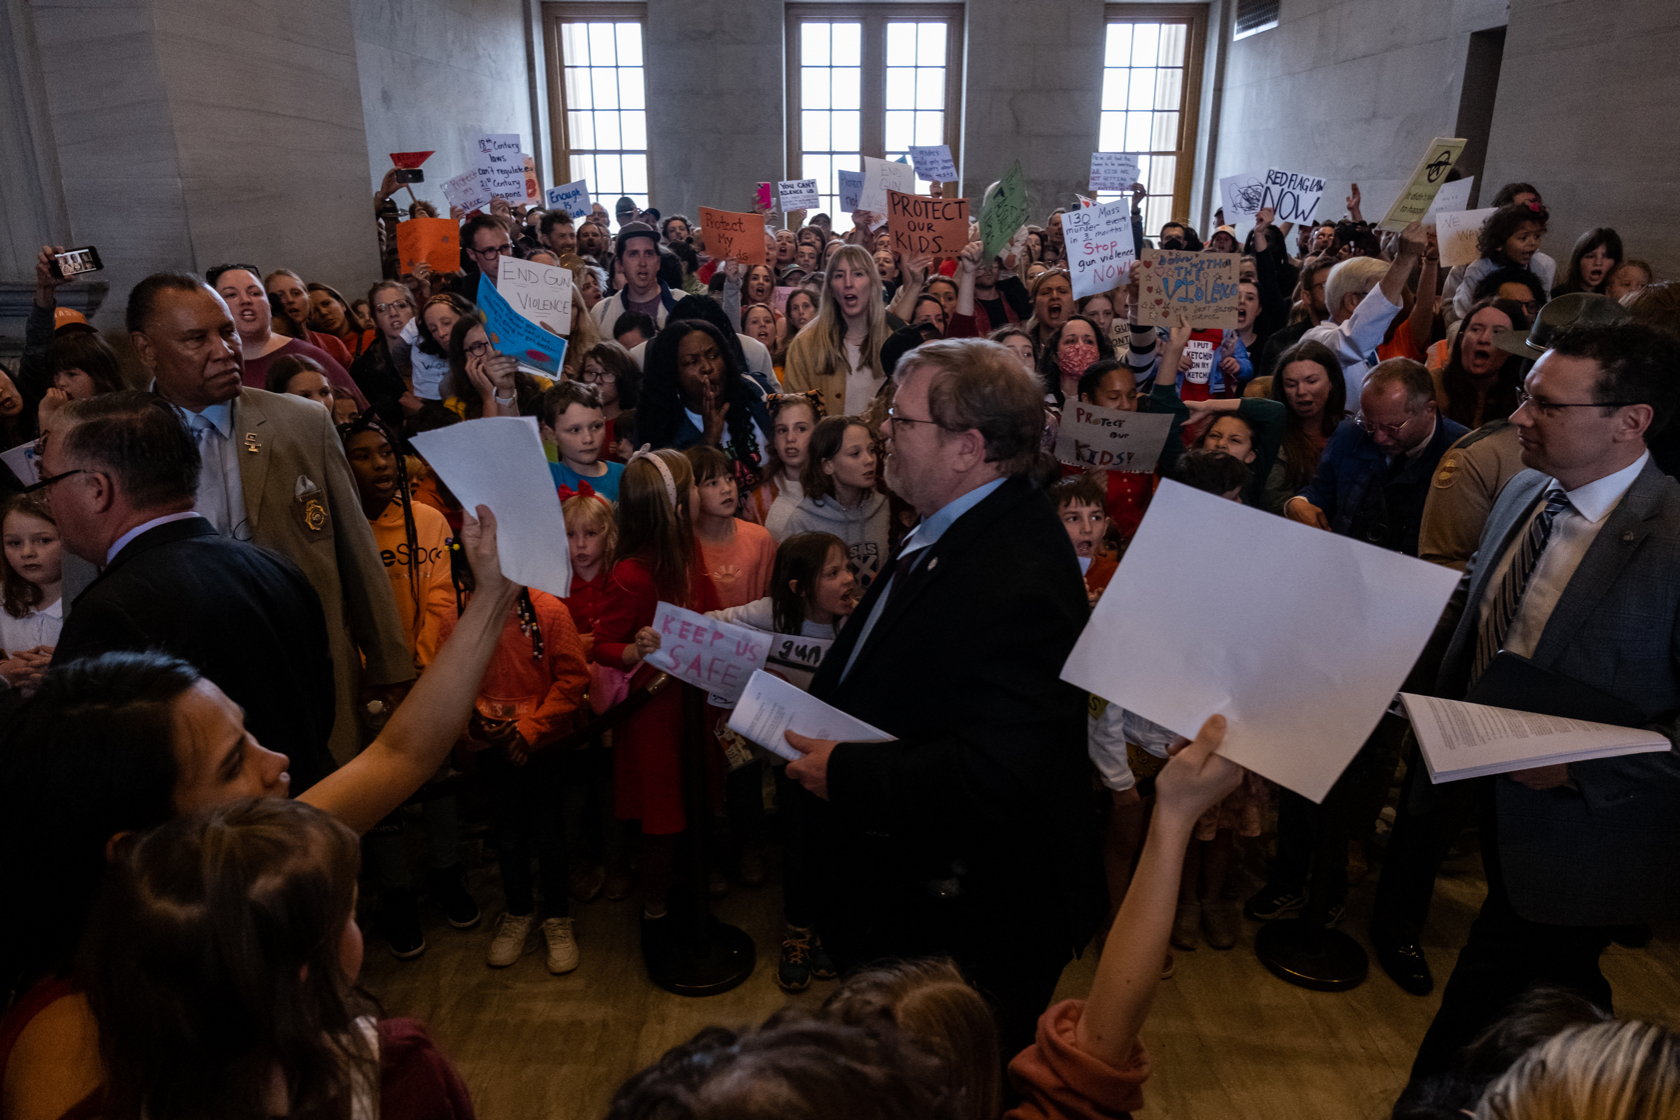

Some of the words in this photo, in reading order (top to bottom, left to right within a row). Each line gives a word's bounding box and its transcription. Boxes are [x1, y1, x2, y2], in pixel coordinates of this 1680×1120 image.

[494, 141, 520, 154] Century
[489, 154, 507, 162] laws
[478, 166, 495, 176] can't
[880, 163, 902, 178] END
[493, 179, 521, 190] Century
[1265, 169, 1288, 187] RED
[1288, 173, 1310, 194] FLAG
[549, 188, 582, 204] Enough
[891, 192, 966, 220] PROTECT
[1260, 186, 1320, 222] NOW
[705, 212, 746, 232] Protect
[1068, 213, 1091, 226] 130
[1098, 206, 1120, 219] Mass
[1440, 214, 1460, 229] WE
[908, 220, 936, 233] OUR
[1066, 224, 1100, 236] murder
[718, 233, 734, 248] My
[896, 231, 958, 254] KIDS...
[1078, 258, 1097, 273] gun
[1100, 248, 1135, 262] violence
[503, 261, 539, 284] END
[544, 269, 570, 288] GUN
[517, 292, 570, 314] VIOLENCE
[1112, 335, 1130, 348] ONT
[1074, 439, 1136, 466] KIDS!
[662, 613, 724, 647] KEEP
[734, 641, 764, 663] US
[778, 640, 821, 665] gun
[665, 644, 741, 688] SAFE
